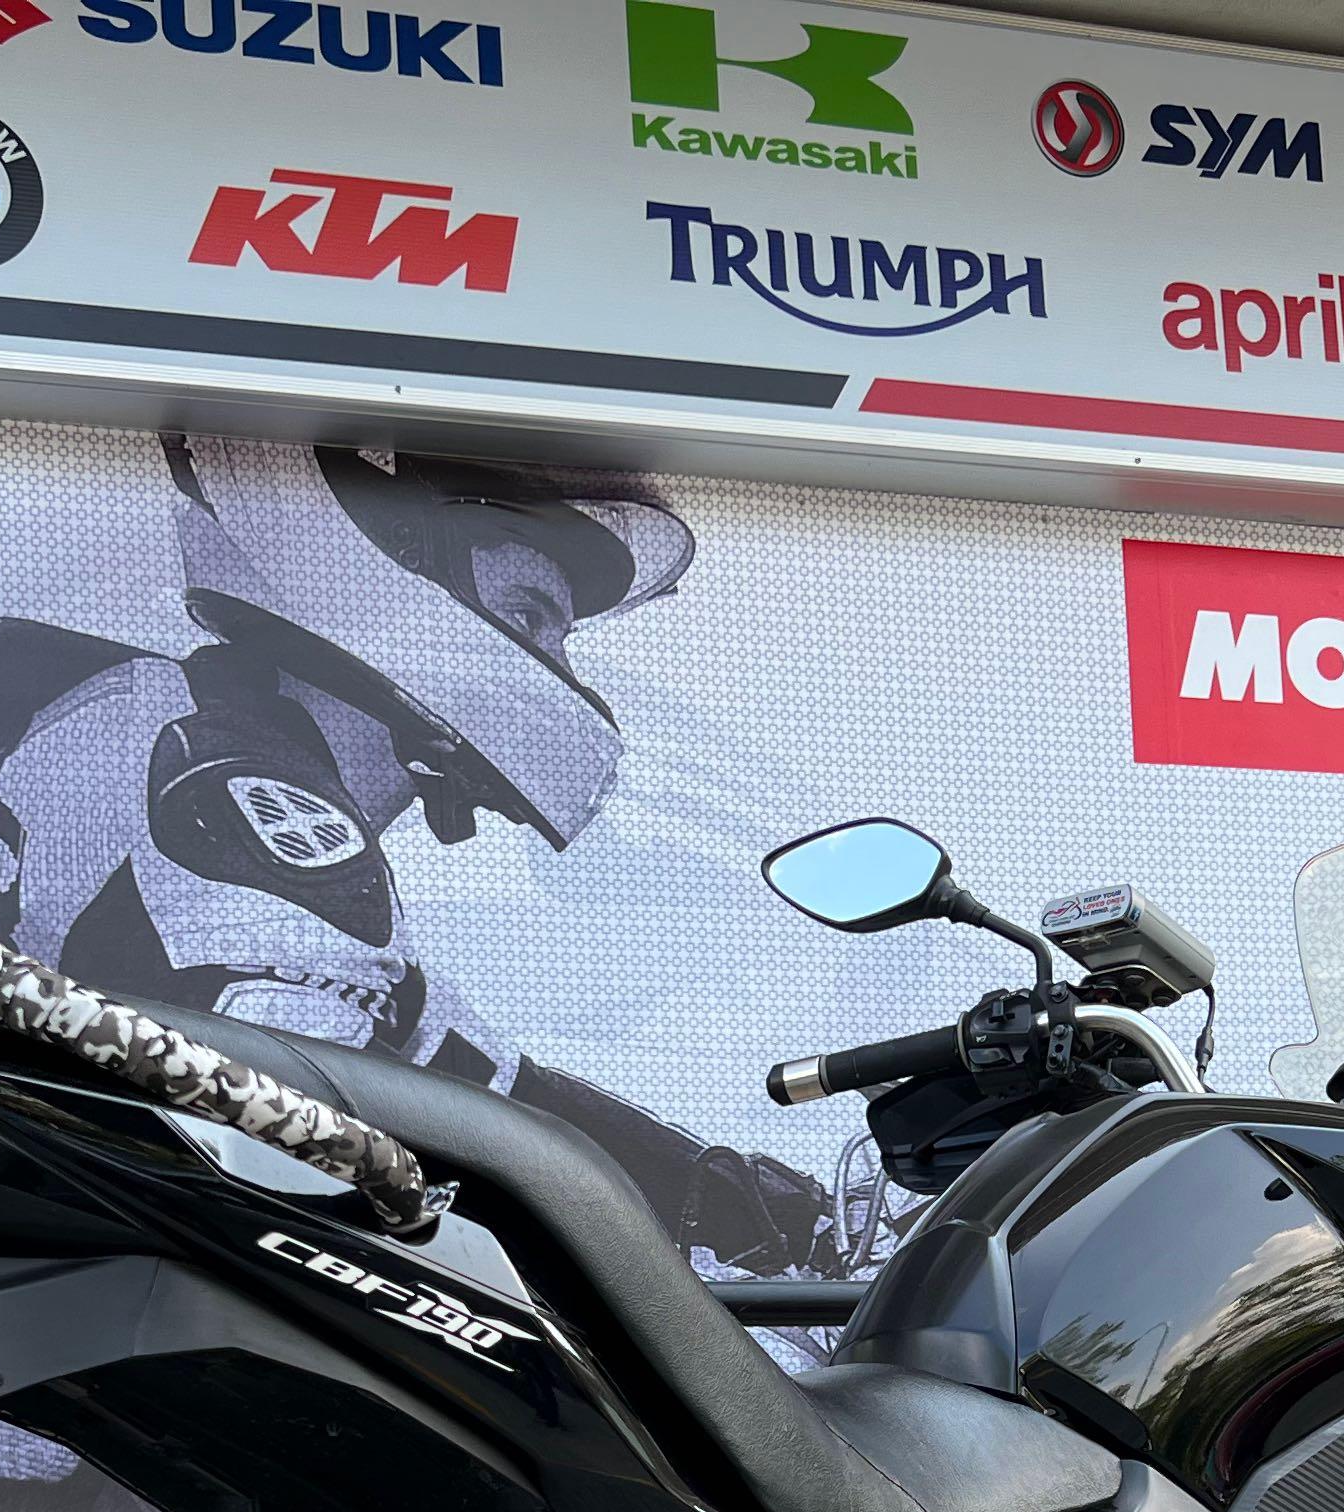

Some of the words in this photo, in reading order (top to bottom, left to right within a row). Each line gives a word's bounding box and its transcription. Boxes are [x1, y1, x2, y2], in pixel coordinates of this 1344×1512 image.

[78, 0, 504, 87] SUZUKI
[631, 112, 919, 180] Kawasaki
[1141, 103, 1324, 183] SYM
[188, 168, 519, 294] KTM
[645, 200, 1048, 336] TRIUMPH
